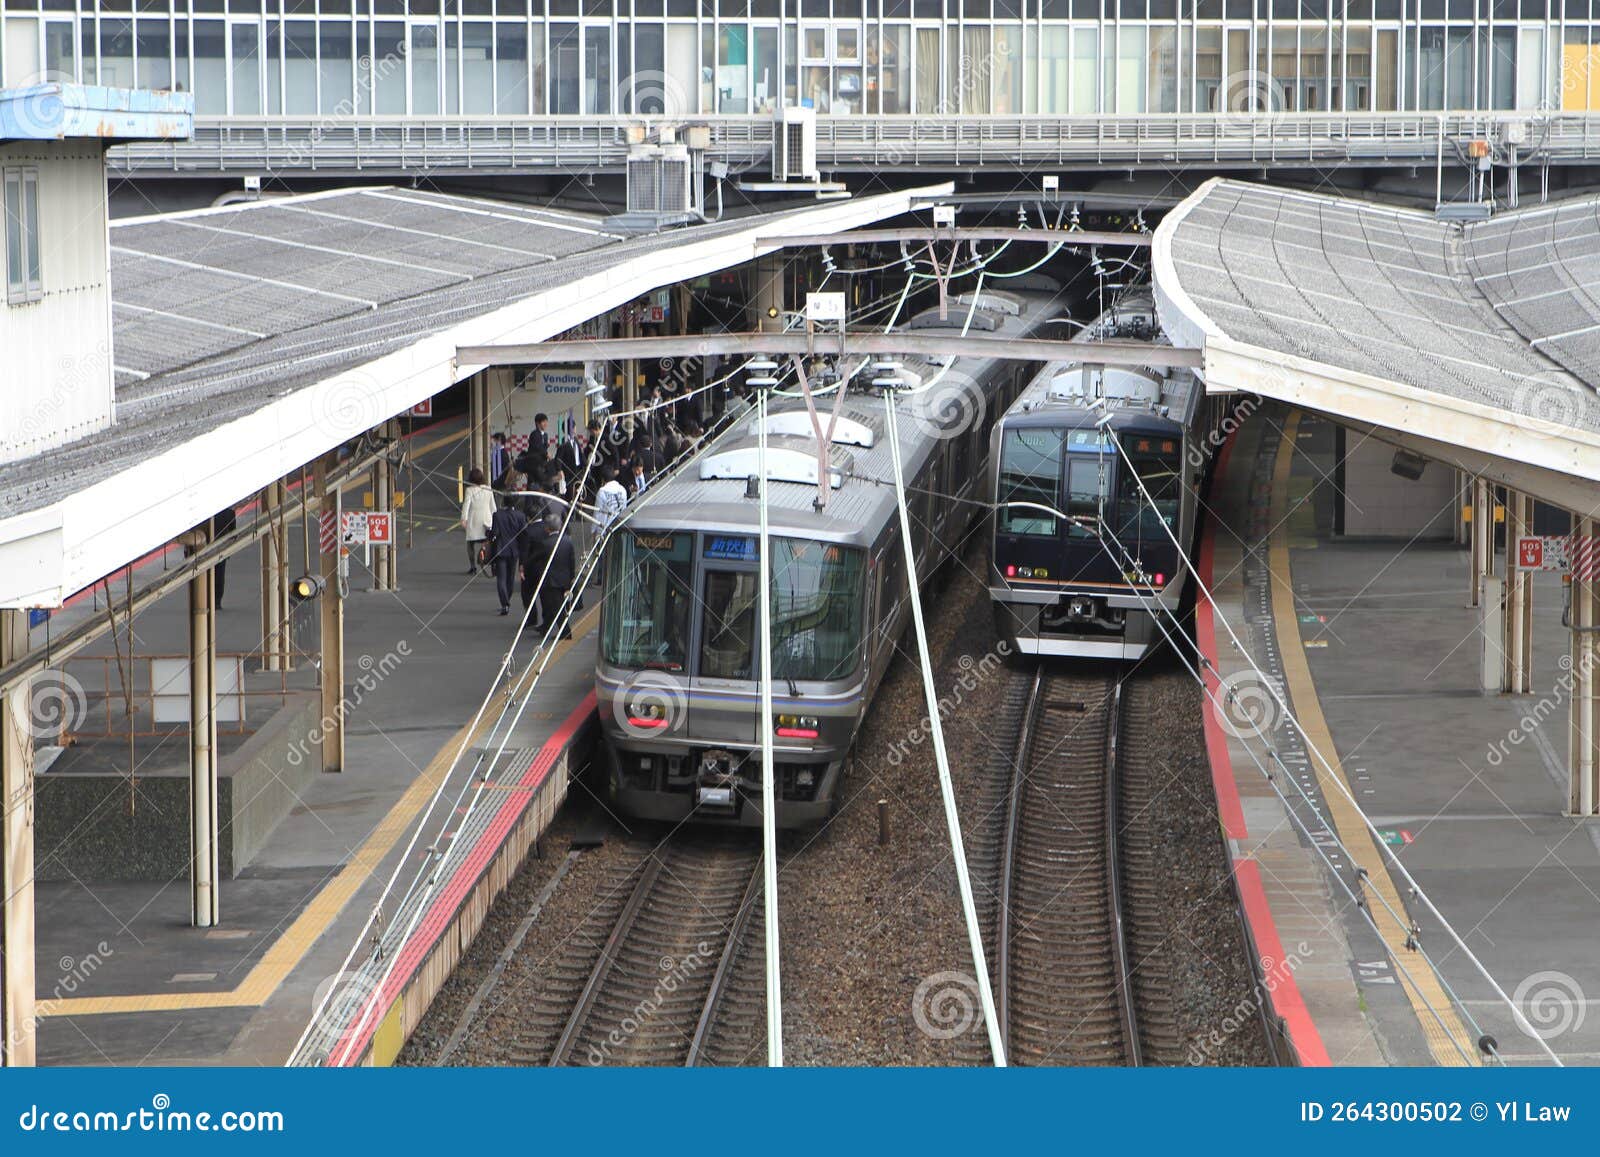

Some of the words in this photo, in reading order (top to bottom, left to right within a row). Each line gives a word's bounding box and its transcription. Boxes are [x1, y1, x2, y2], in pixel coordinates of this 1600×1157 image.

[785, 314, 804, 329] 12
[543, 374, 583, 385] Vending
[545, 385, 581, 394] Corner
[1522, 543, 1540, 551] SOS
